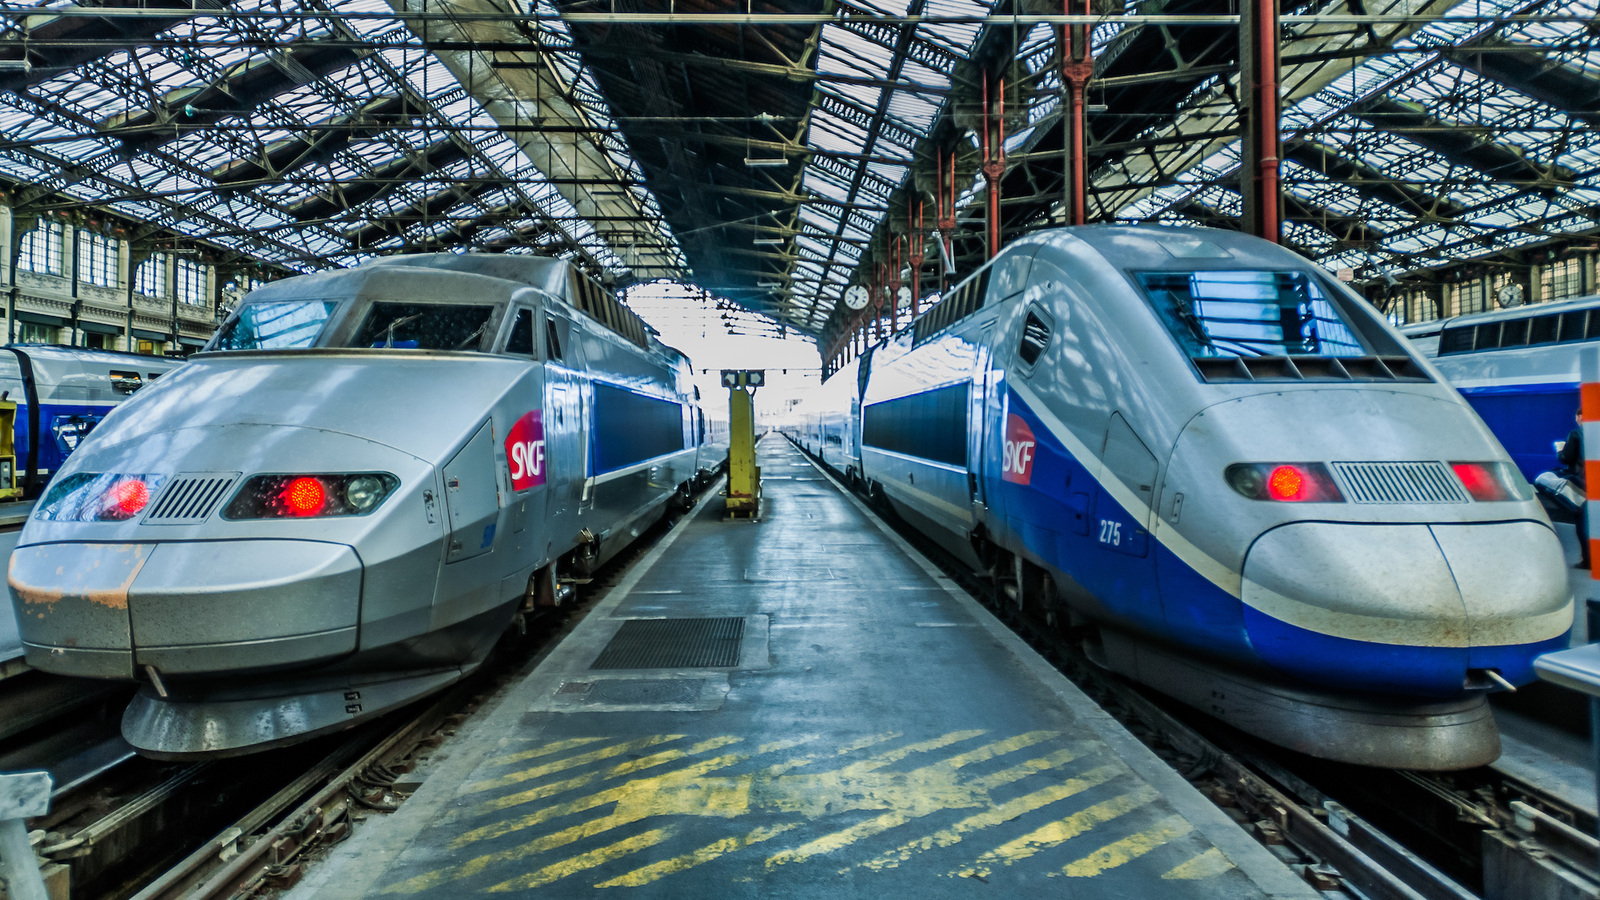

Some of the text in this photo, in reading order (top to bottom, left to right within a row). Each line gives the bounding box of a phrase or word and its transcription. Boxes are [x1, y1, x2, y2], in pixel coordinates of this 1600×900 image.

[511, 440, 545, 480] SNCF
[1003, 440, 1035, 475] SNCF
[1099, 519, 1122, 547] 275
